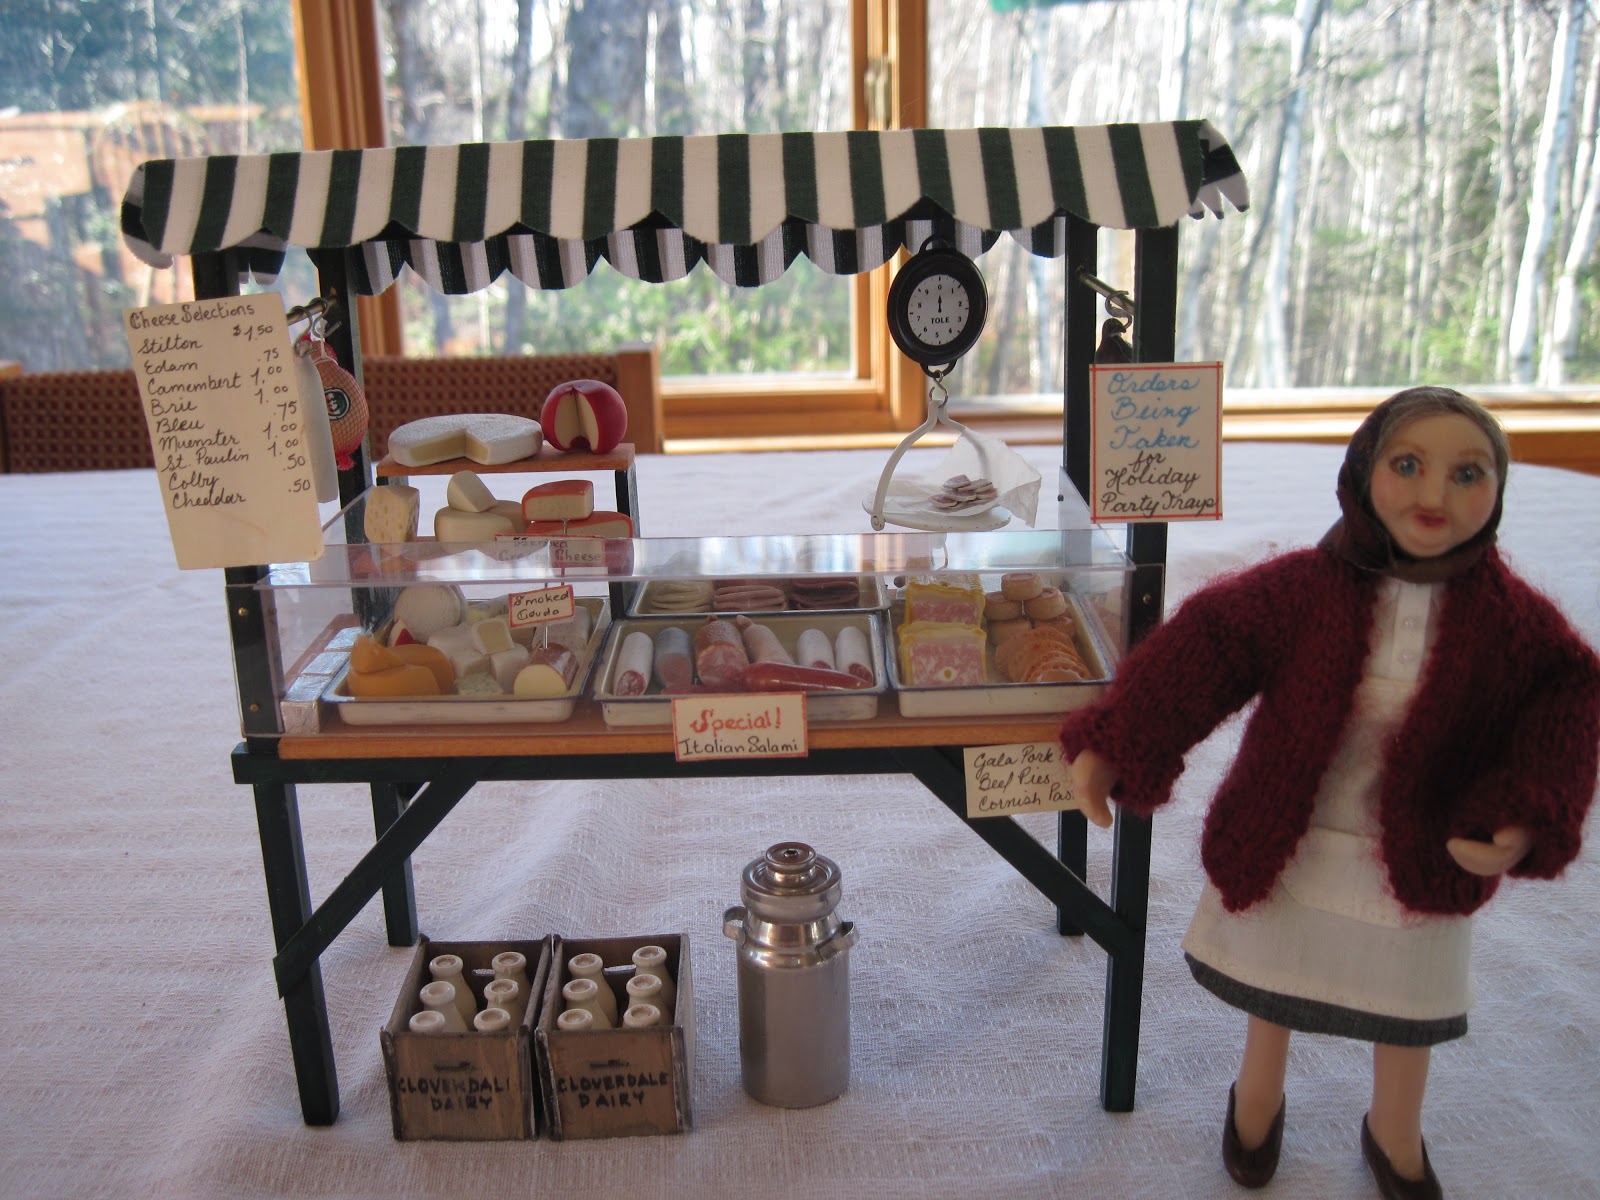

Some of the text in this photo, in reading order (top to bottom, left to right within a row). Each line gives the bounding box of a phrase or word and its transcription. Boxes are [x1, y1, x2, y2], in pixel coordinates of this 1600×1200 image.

[129, 302, 255, 329] Cheese Selections
[930, 316, 950, 324] TOLE
[138, 324, 273, 354] Stilton $1.50
[144, 347, 279, 375] Edam .75
[148, 366, 282, 396] Camembert 1.00
[1108, 372, 1200, 394] Orders
[151, 385, 289, 416] Brie 1.00
[1111, 396, 1200, 427] Being
[156, 400, 297, 433] Bleu .75
[159, 421, 297, 452] Muenster 1.00
[1110, 425, 1199, 449] Taken
[161, 438, 299, 472] St. Paulin 1.00
[1128, 450, 1166, 473] for
[169, 453, 306, 494] Colby .50
[1105, 467, 1200, 495] Holiday
[172, 478, 311, 509] Cheddar .50
[1101, 490, 1216, 518] Party Trays
[555, 548, 601, 560] Cheese
[513, 589, 569, 607] Smoked
[516, 609, 560, 621] Gouda
[689, 706, 782, 737] Special!
[678, 735, 799, 756] Italian Salami
[973, 752, 1018, 779] Gala
[1022, 745, 1053, 762] Pork
[979, 766, 1050, 793] Beef Pies
[979, 782, 1074, 812] Cornish Pas
[557, 1071, 668, 1093] CLOVERDALE
[430, 1095, 493, 1111] DAIRY
[578, 1090, 644, 1109] DAIRY
